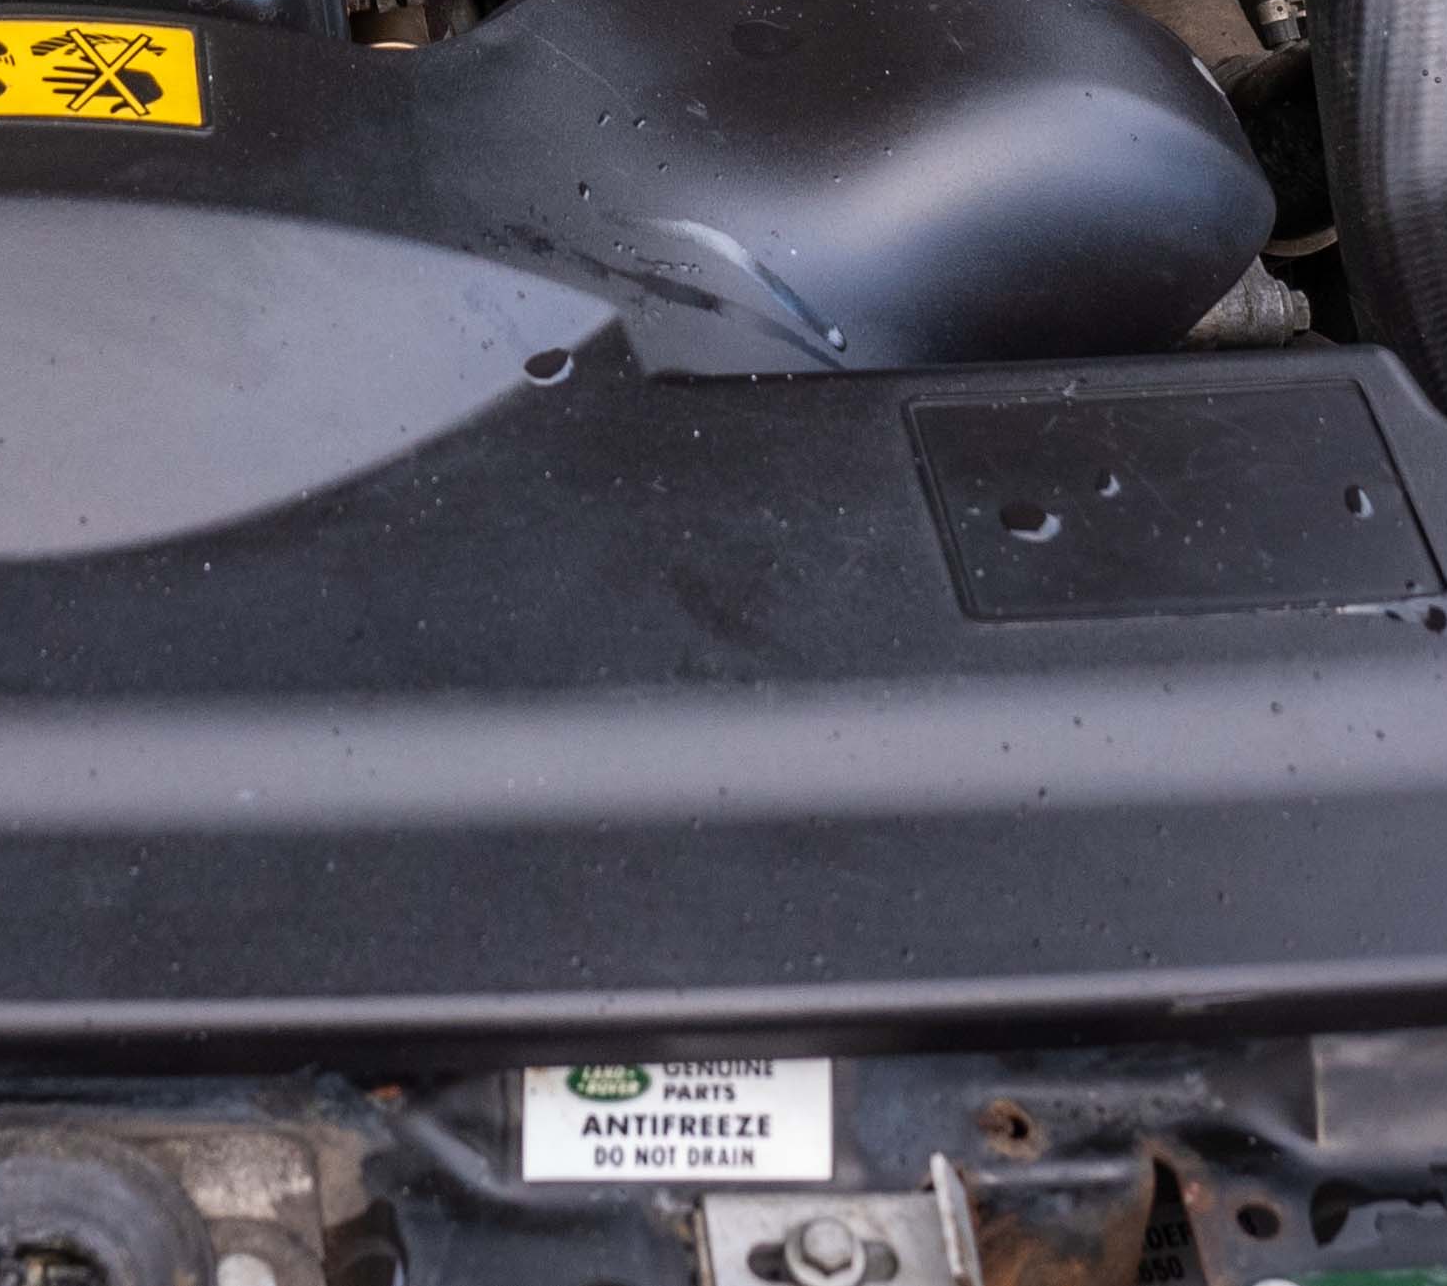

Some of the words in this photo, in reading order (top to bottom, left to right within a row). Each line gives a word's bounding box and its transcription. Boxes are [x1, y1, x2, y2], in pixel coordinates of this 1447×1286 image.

[663, 1084, 736, 1101] PARTS
[582, 1114, 772, 1137] ANTIFREEZE
[595, 1147, 623, 1167] DO
[635, 1147, 676, 1167] NOT
[687, 1147, 755, 1167] DRAIN
